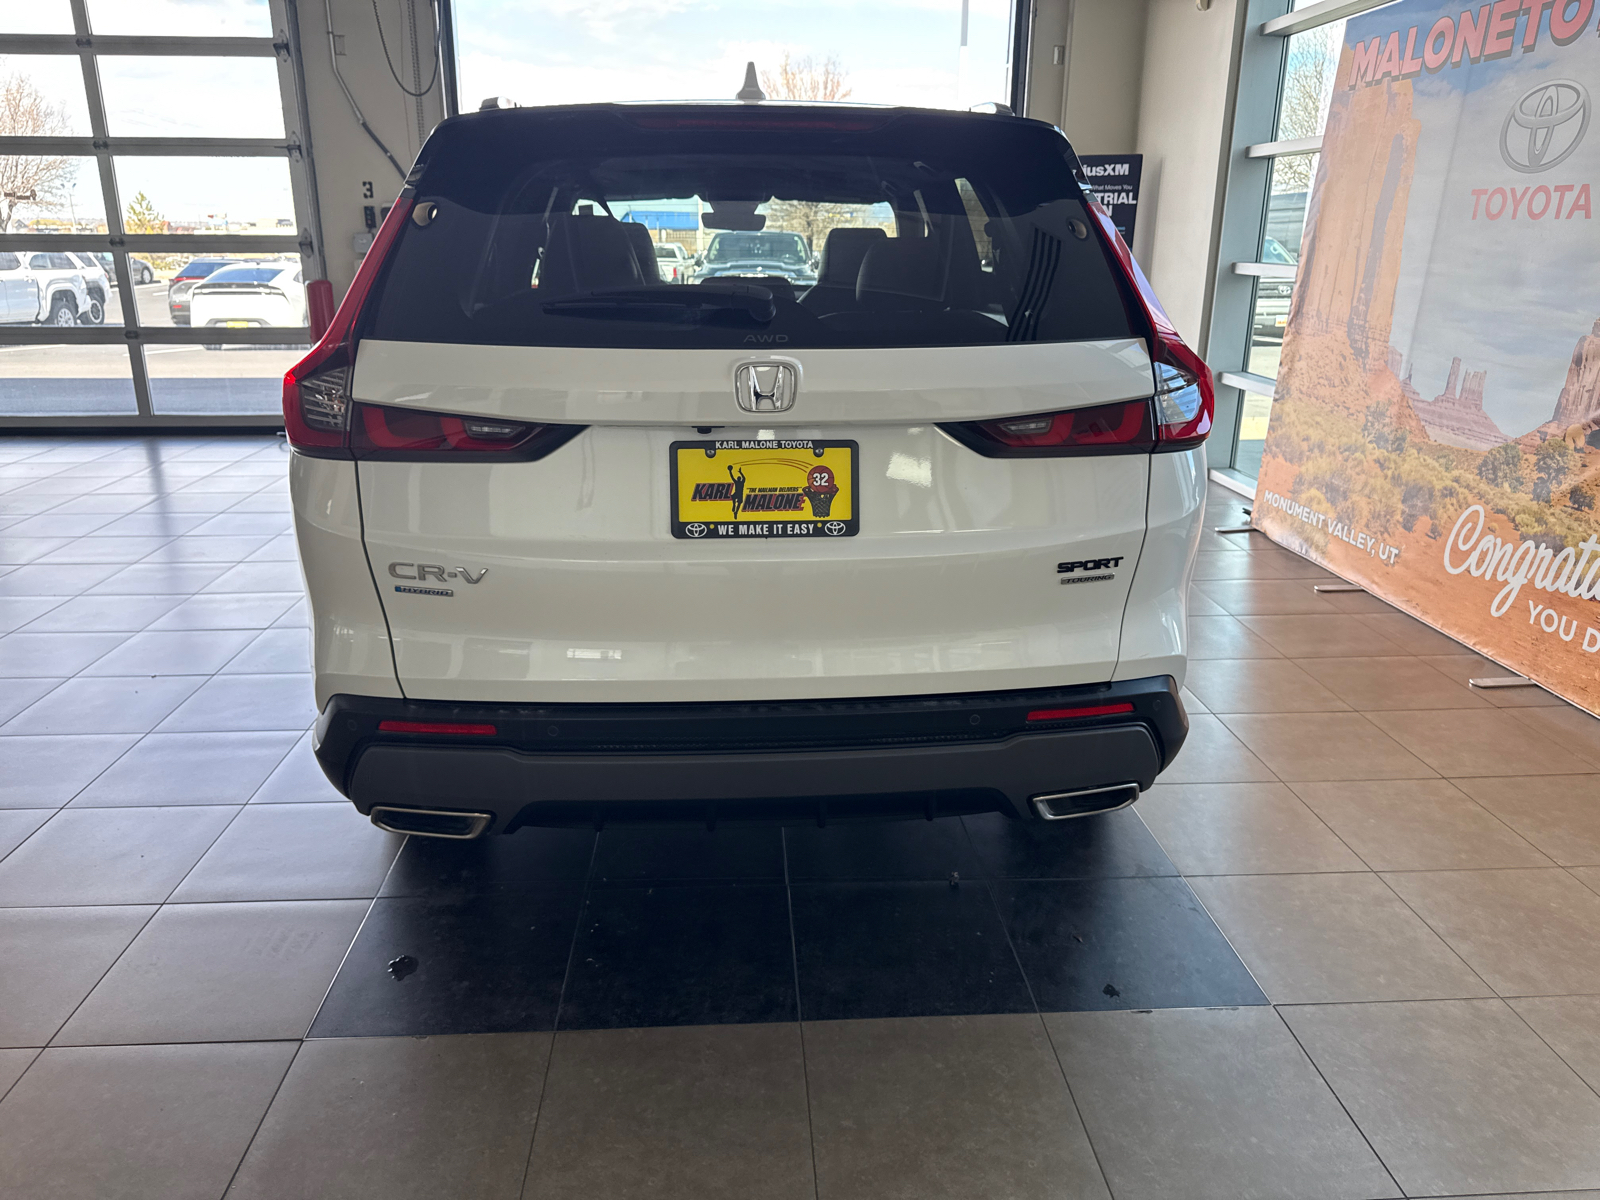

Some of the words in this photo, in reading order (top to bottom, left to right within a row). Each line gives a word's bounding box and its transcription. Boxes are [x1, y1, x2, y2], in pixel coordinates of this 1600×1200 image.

[1348, 0, 1600, 90] MALONETO
[1083, 163, 1130, 177] iusXM
[362, 181, 374, 199] 3
[1095, 191, 1137, 205] TRIAL
[1471, 183, 1592, 221] TOYOTA
[743, 334, 789, 343] AWD
[715, 440, 740, 449] KARL
[741, 440, 779, 449] MALONE
[780, 440, 813, 449] TOYOTA
[812, 472, 829, 487] 32
[691, 482, 734, 501] KARL
[741, 493, 806, 512] MALONE
[717, 524, 735, 536] WE
[738, 523, 769, 535] MAKE
[773, 523, 784, 535] IT
[787, 523, 815, 535] EASY
[1263, 489, 1325, 529] MONUMENT
[1327, 518, 1376, 557] VALLEY,
[1378, 542, 1399, 564] UT
[388, 561, 489, 584] CR-V
[1057, 556, 1124, 573] SPORT
[1065, 574, 1112, 584] TOURING
[401, 586, 450, 597] HYBRID
[1528, 599, 1578, 642] YOU
